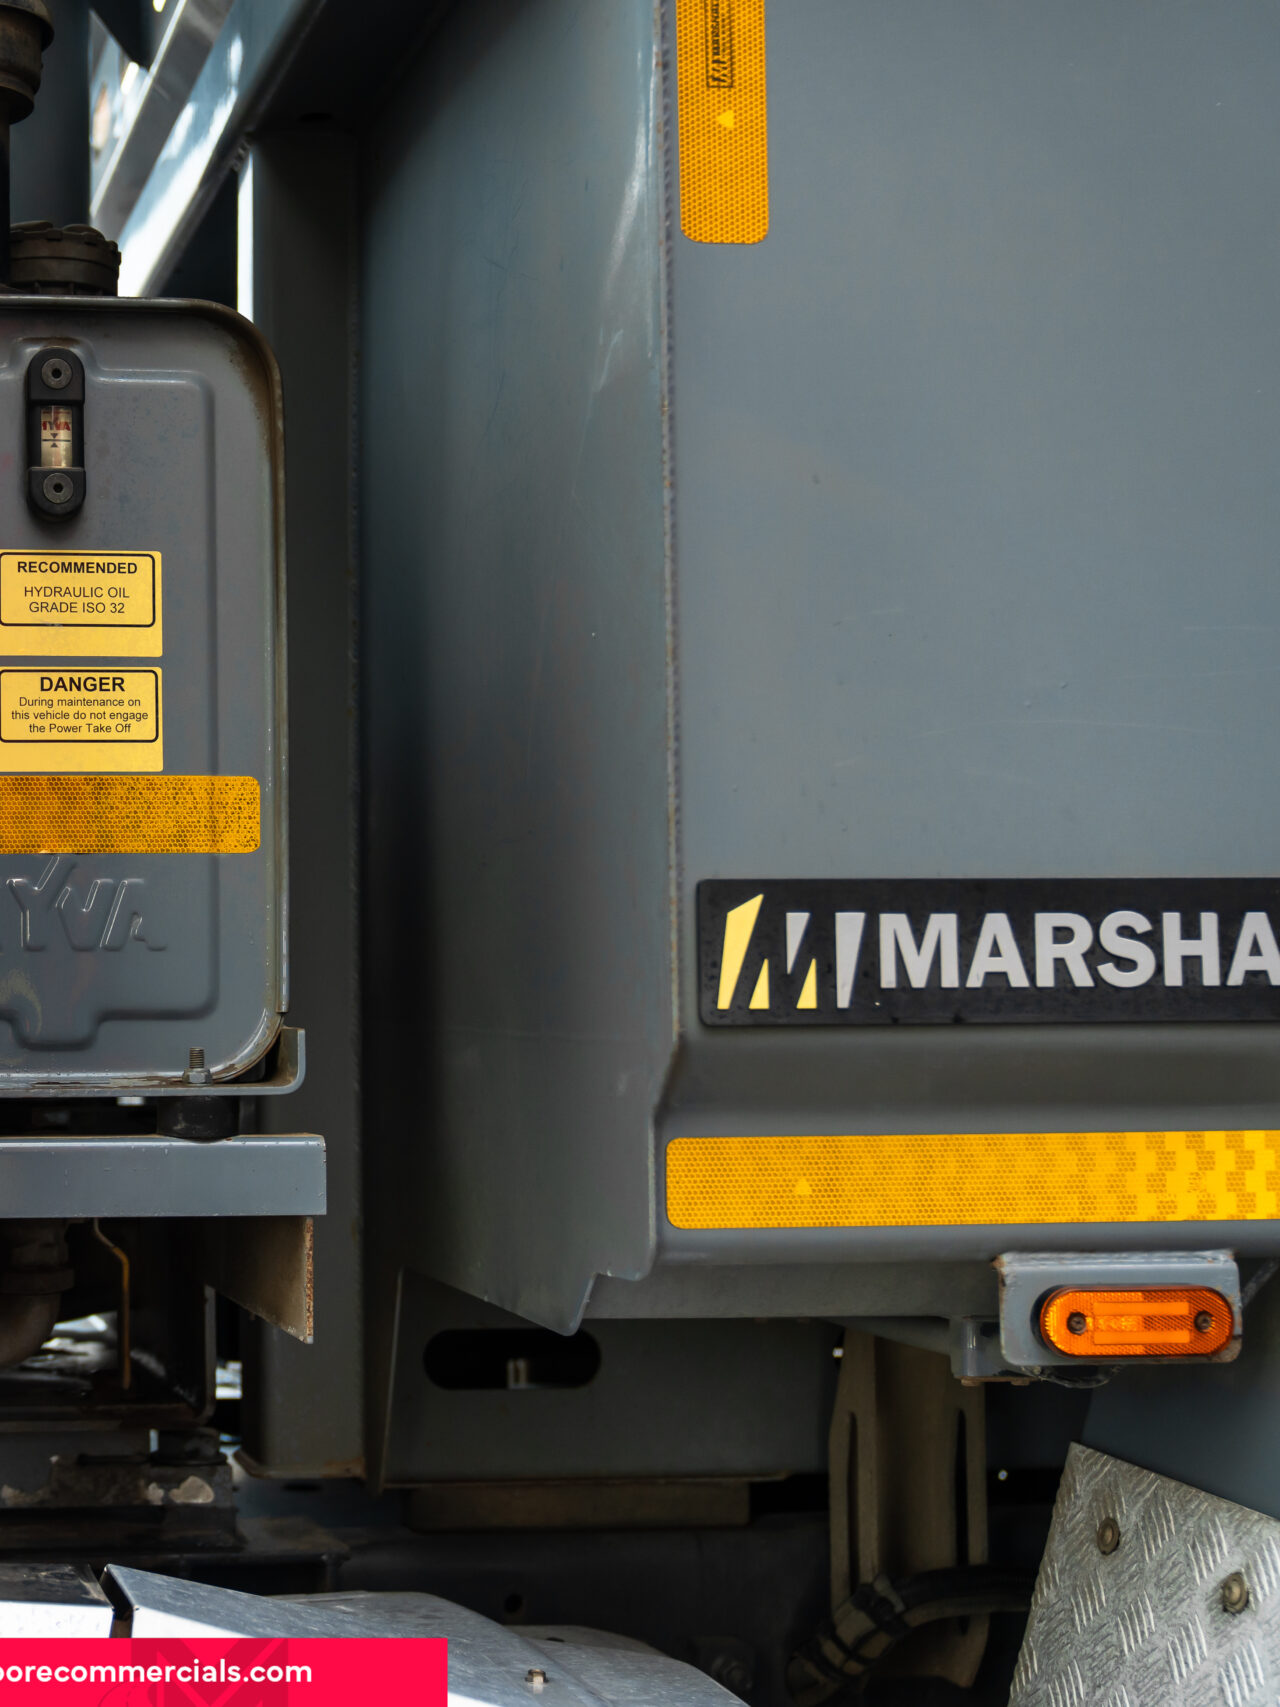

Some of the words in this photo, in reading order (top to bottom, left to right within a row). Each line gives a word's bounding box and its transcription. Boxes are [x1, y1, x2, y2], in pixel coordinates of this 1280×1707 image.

[17, 561, 138, 574] RECOMMENDED
[24, 586, 104, 598] HYDRAULIC
[107, 587, 130, 599] OIL
[29, 601, 78, 613] GRADE
[82, 602, 106, 614] ISO
[110, 602, 125, 614] 32
[40, 676, 126, 692] DANGER
[19, 696, 54, 708] During
[57, 697, 125, 707] maintenance
[127, 699, 141, 707] on
[11, 710, 30, 720] this
[33, 710, 70, 720] vehicle
[73, 710, 87, 720] do
[89, 711, 107, 720] not
[109, 711, 149, 722] engage
[29, 723, 46, 733] the
[49, 723, 83, 733] Power
[85, 723, 112, 733] Take
[115, 723, 132, 733] Off
[879, 909, 1280, 989] MARSHA
